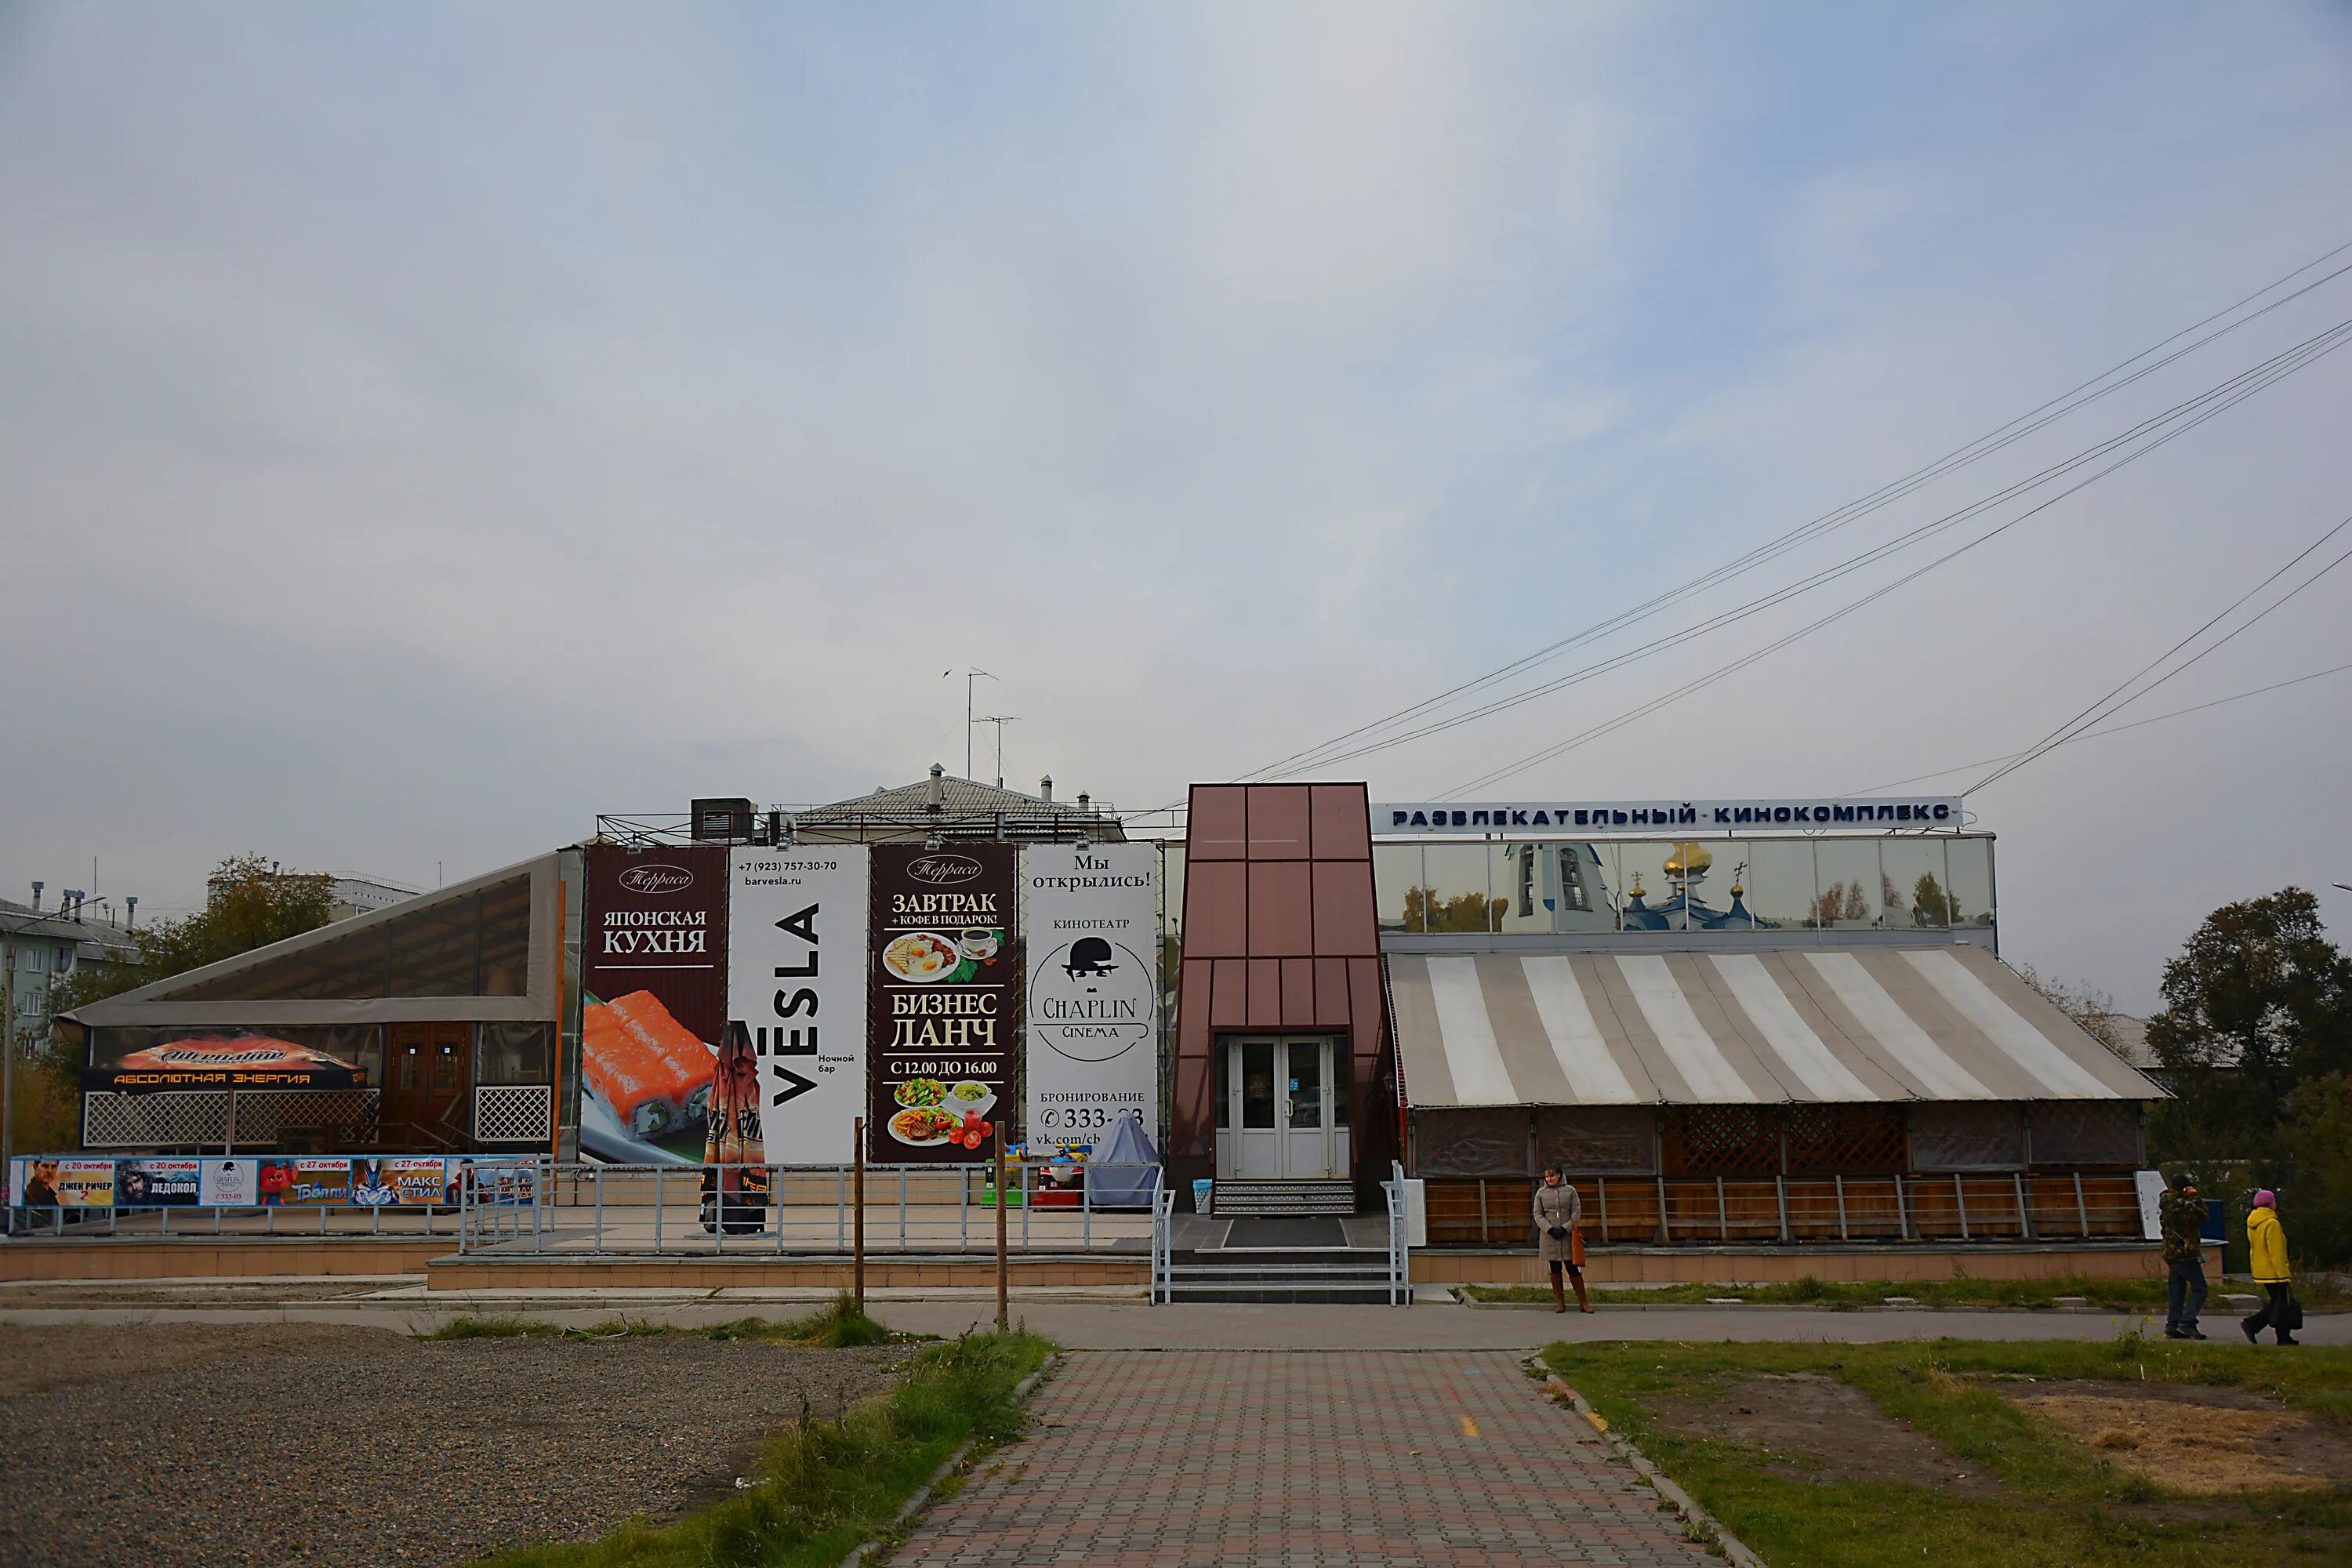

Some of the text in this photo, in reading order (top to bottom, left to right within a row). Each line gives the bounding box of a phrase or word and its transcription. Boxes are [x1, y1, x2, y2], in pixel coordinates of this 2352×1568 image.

[1392, 802, 1949, 826] РАЗВЛЕКАТЕЛЬНЫЙ КИНОКОМПЛЕКС
[739, 862, 837, 872] +7 (923) 757-30-70
[1074, 855, 1109, 869] Мы
[914, 859, 978, 882] Терраса
[626, 869, 690, 891] Терраса
[745, 877, 801, 885] barvesla.ru
[1033, 872, 1150, 892] открылись!
[892, 894, 996, 913] ЗАВТРАК
[603, 911, 706, 926] ЯПОНСКАЯ
[900, 916, 931, 924] КОФЕ
[941, 915, 997, 926] ПОДАРОК!
[1054, 919, 1130, 929] КИНОТЕАТР
[603, 930, 706, 953] КУХНЯ
[891, 993, 996, 1014] БИЗНЕС
[1044, 997, 1137, 1018] CHAPLIN
[891, 1018, 996, 1047] ЛАНЧ
[1062, 1026, 1120, 1037] CINEMA
[818, 1054, 855, 1063] Ночной
[818, 1065, 836, 1074] бар
[891, 1062, 997, 1076] С 12.00 ДО 16.00
[114, 1073, 310, 1084] АБСОЛЮТНАЯ ЭНЕРГИЯ
[1040, 1092, 1145, 1102] БРОНИРОВАНИЕ
[1064, 1108, 1144, 1128] 333-3
[84, 1162, 113, 1171] октября
[169, 1162, 198, 1171] октября
[58, 1182, 113, 1192] ДЖЕК РИЧЕР
[397, 1176, 441, 1187] МАКС
[151, 1182, 197, 1195] ЛЕДОКОЛ
[292, 1182, 347, 1202] Тролли
[401, 1187, 442, 1198] СТИЛ
[81, 1191, 89, 1200] 2
